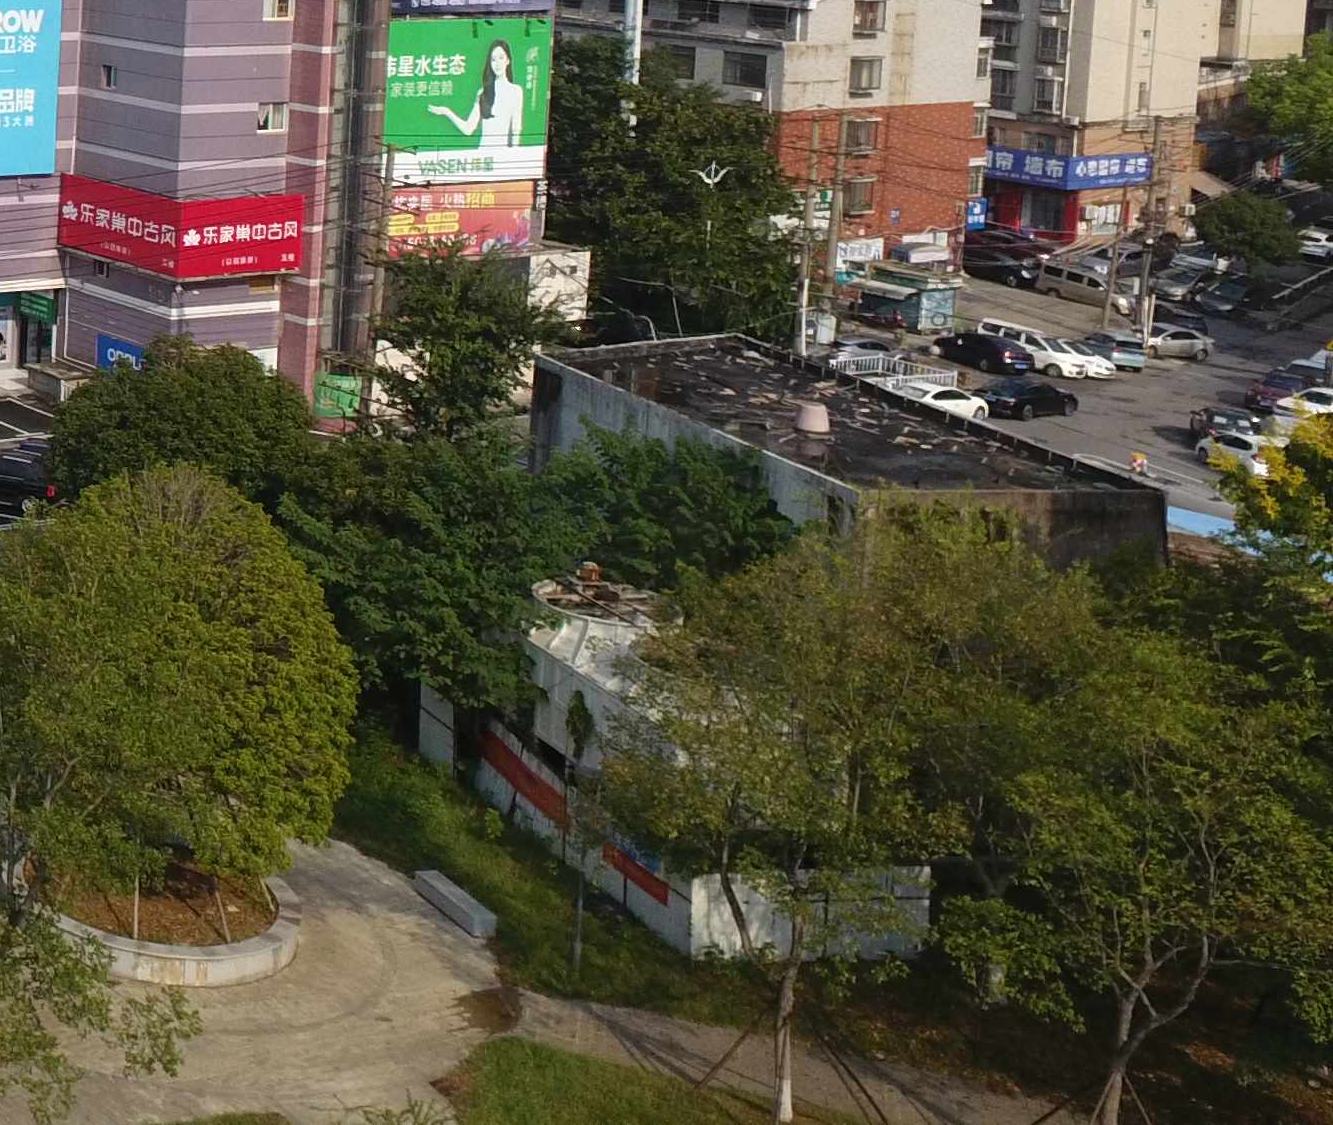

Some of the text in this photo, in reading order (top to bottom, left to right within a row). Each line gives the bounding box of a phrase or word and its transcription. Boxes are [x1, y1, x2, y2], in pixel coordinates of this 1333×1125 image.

[390, 80, 453, 98] 家装更信赖
[1024, 155, 1066, 178] 墙布
[80, 203, 176, 248] 乐家巢中古风
[203, 221, 298, 244] 乐家巢中古风
